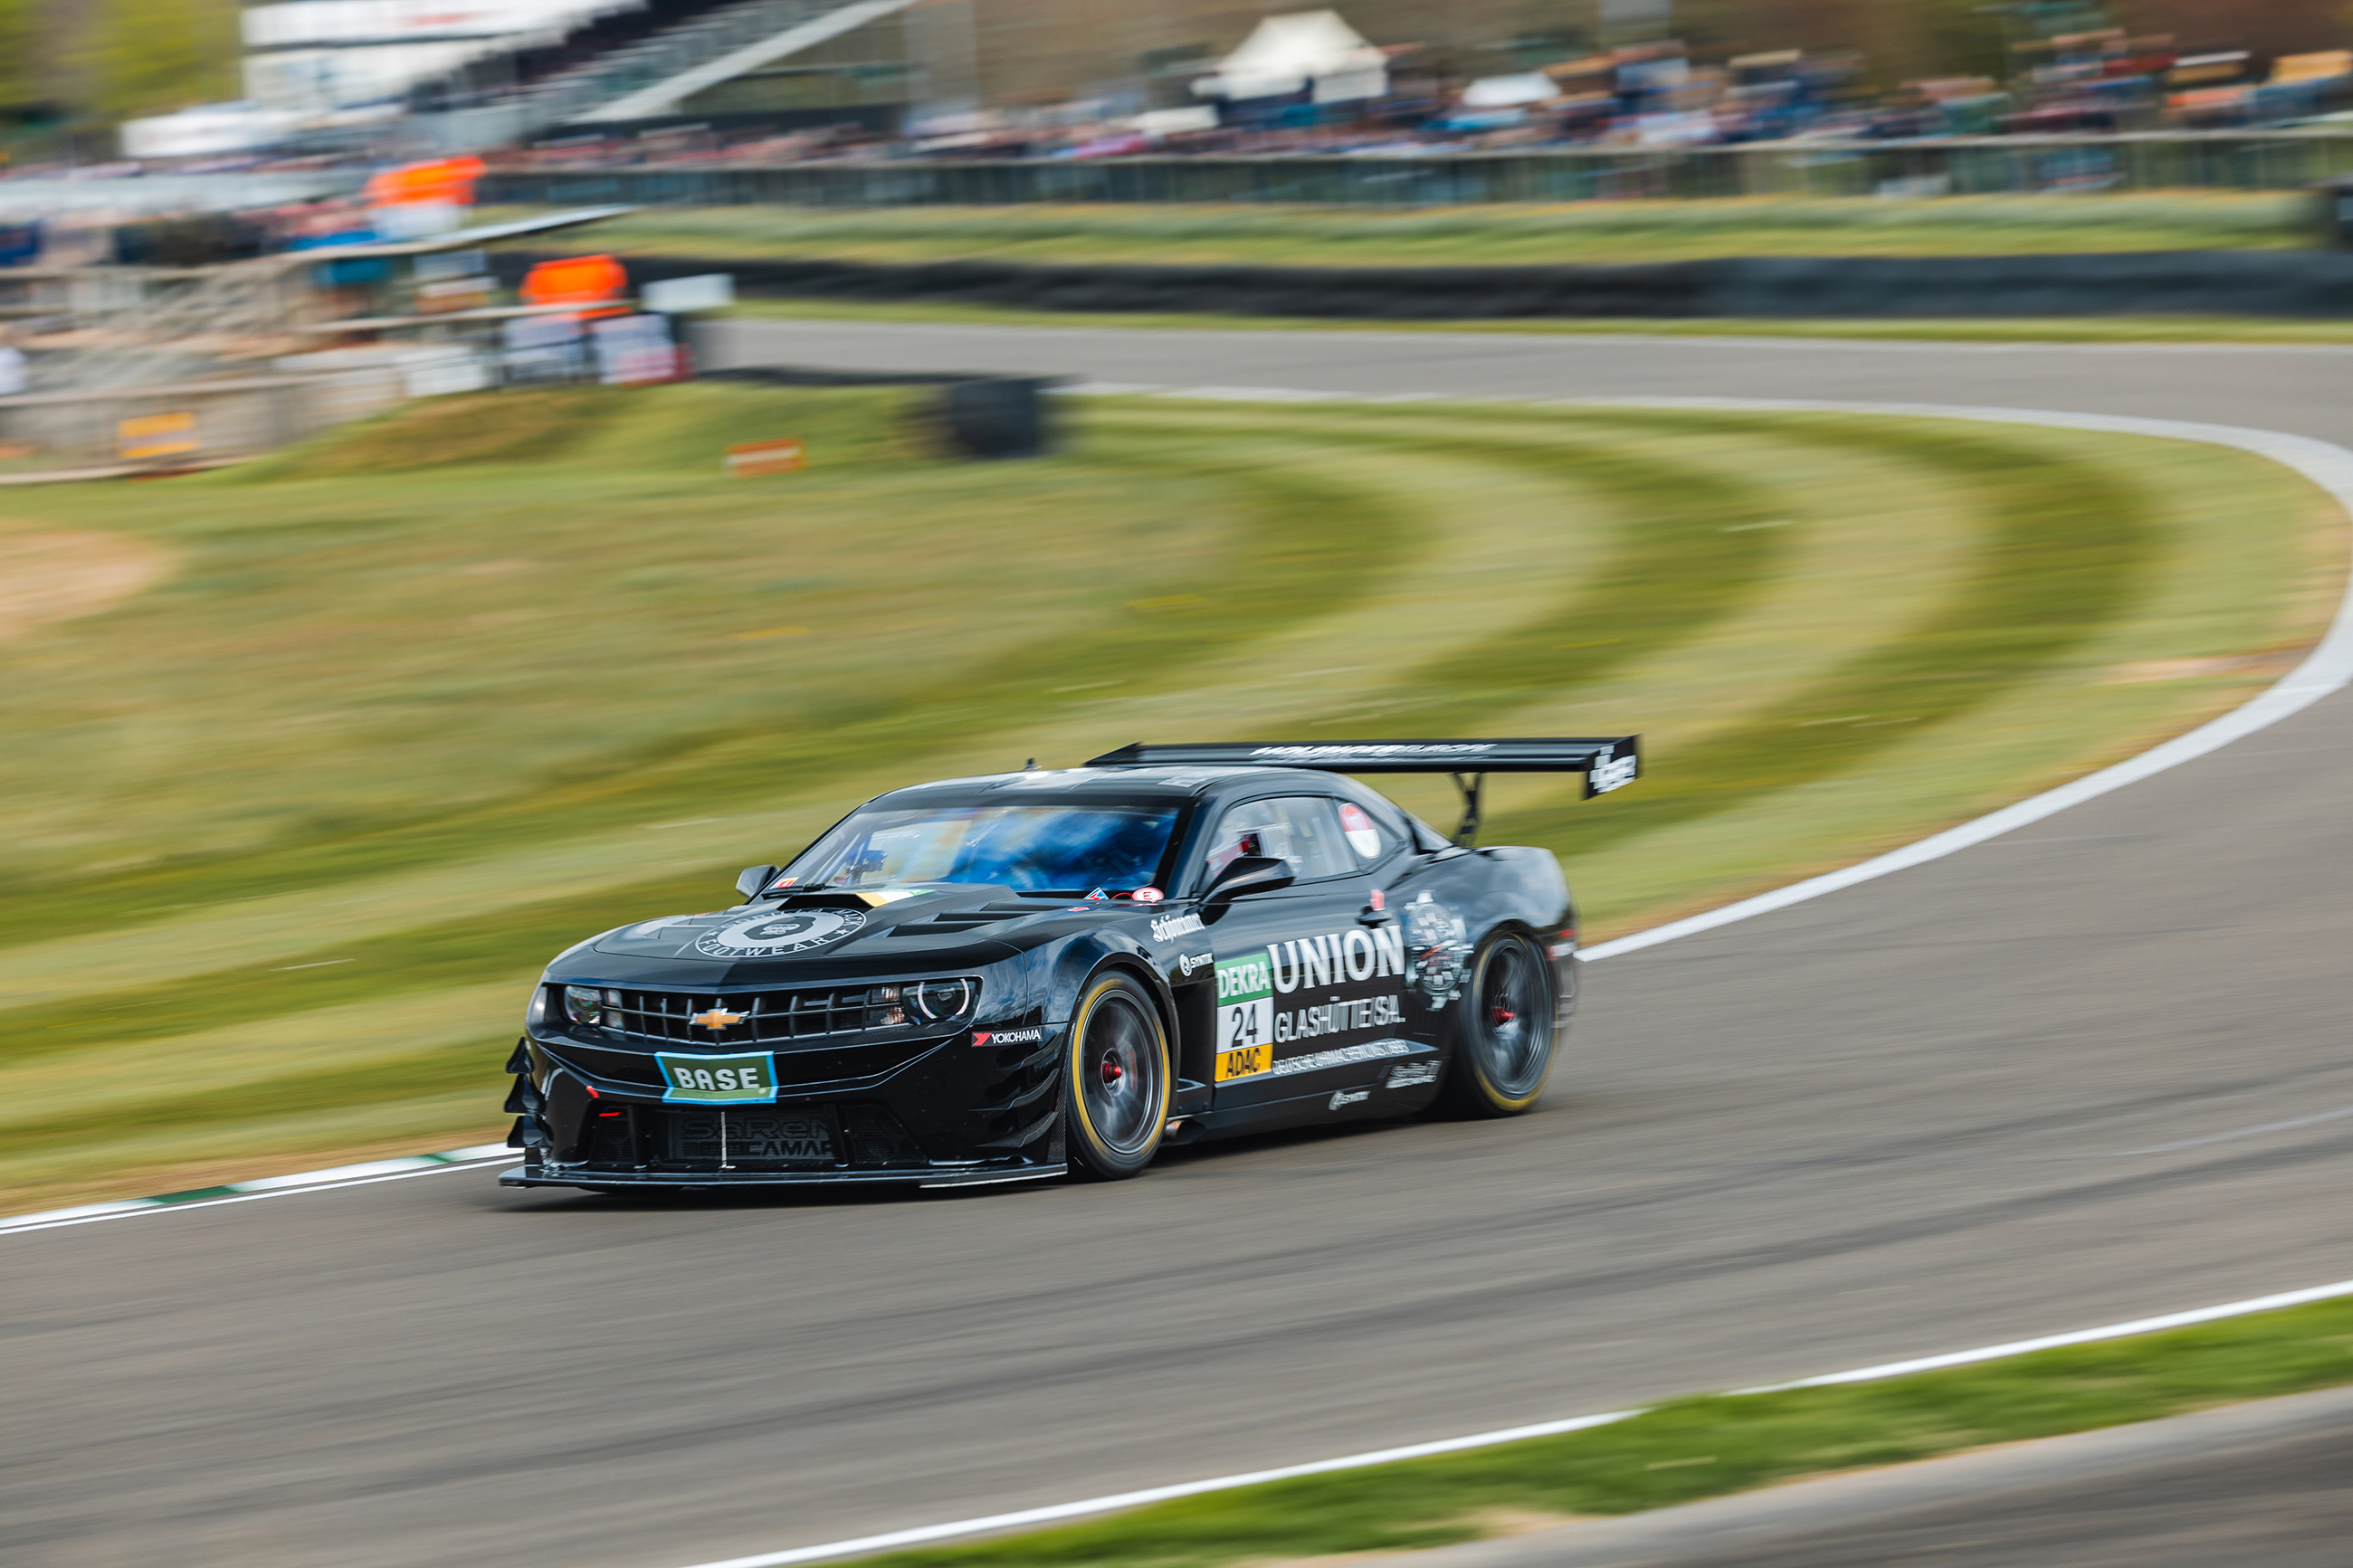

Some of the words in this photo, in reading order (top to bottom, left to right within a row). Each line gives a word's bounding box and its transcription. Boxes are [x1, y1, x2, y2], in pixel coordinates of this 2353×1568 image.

[700, 936, 829, 956] FOOTWEAR
[1266, 925, 1405, 993] UNION
[1217, 961, 1271, 999] DEKRA
[991, 1029, 1041, 1044] YOKOHAMA
[1230, 1003, 1260, 1048] 24
[672, 1068, 760, 1090] BASE
[1225, 1047, 1261, 1079] ADAC
